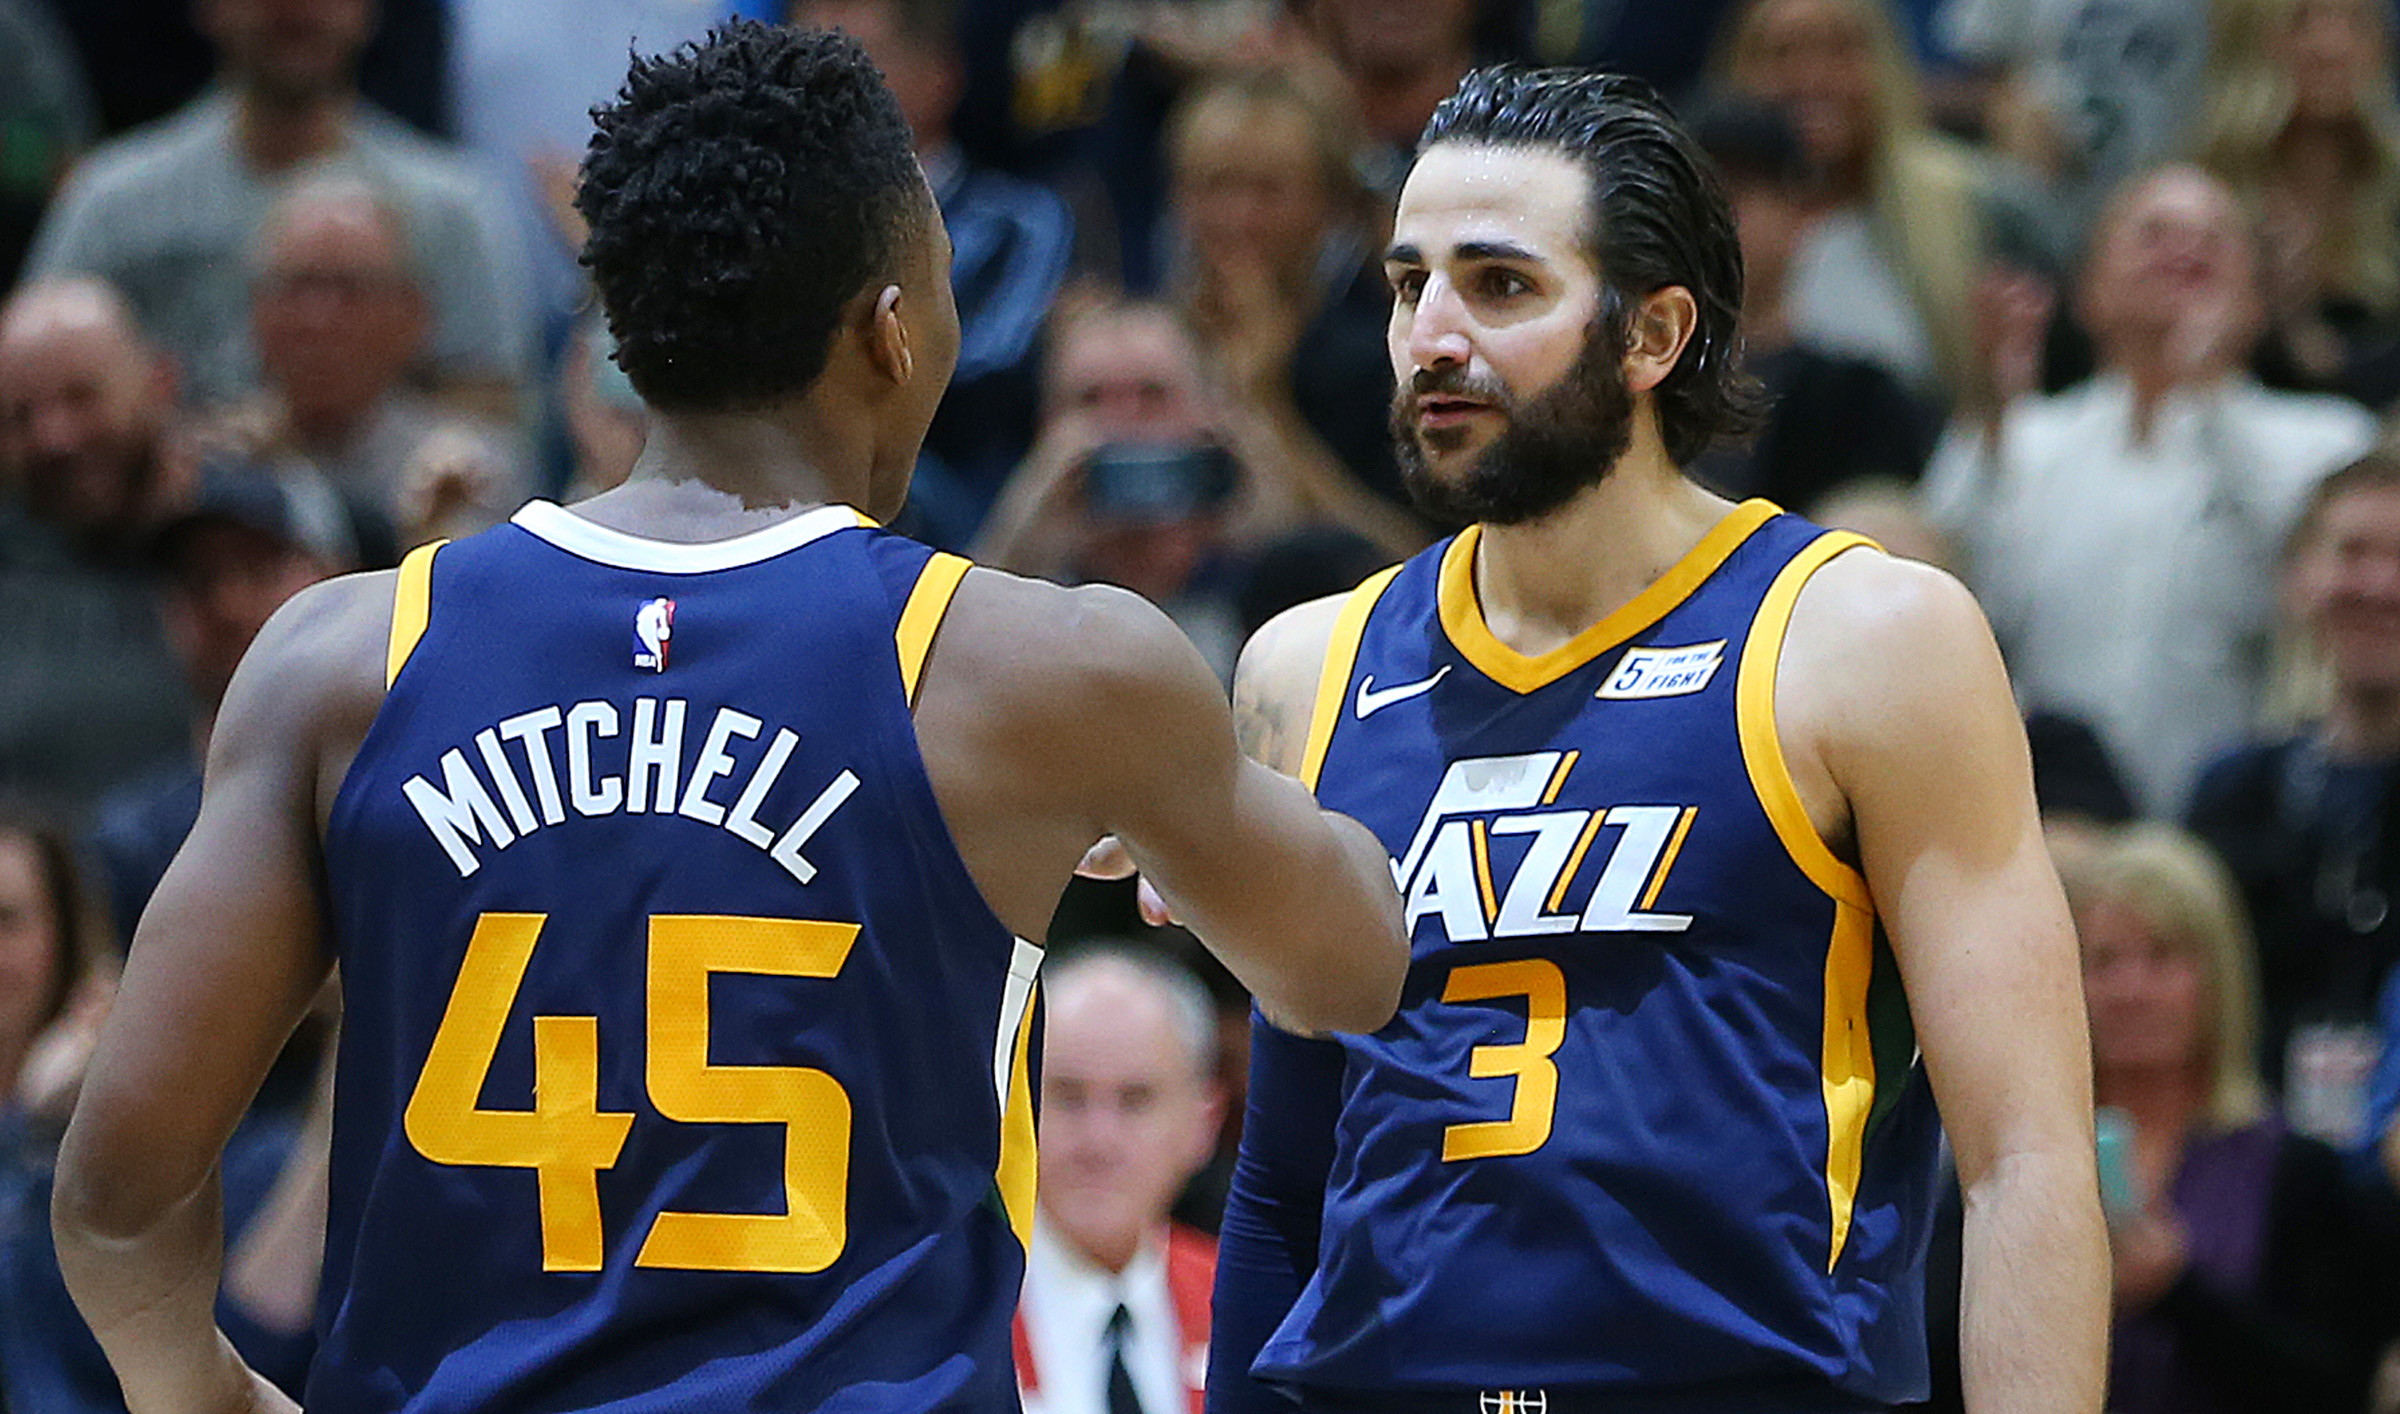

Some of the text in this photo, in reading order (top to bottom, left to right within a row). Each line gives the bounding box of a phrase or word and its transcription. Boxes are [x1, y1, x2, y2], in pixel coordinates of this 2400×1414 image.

[1614, 657, 1654, 691] 5
[1646, 667, 1708, 690] FIGHT
[403, 699, 861, 883] MITCHELL
[404, 913, 862, 1272] 45
[1442, 959, 1567, 1162] 3
